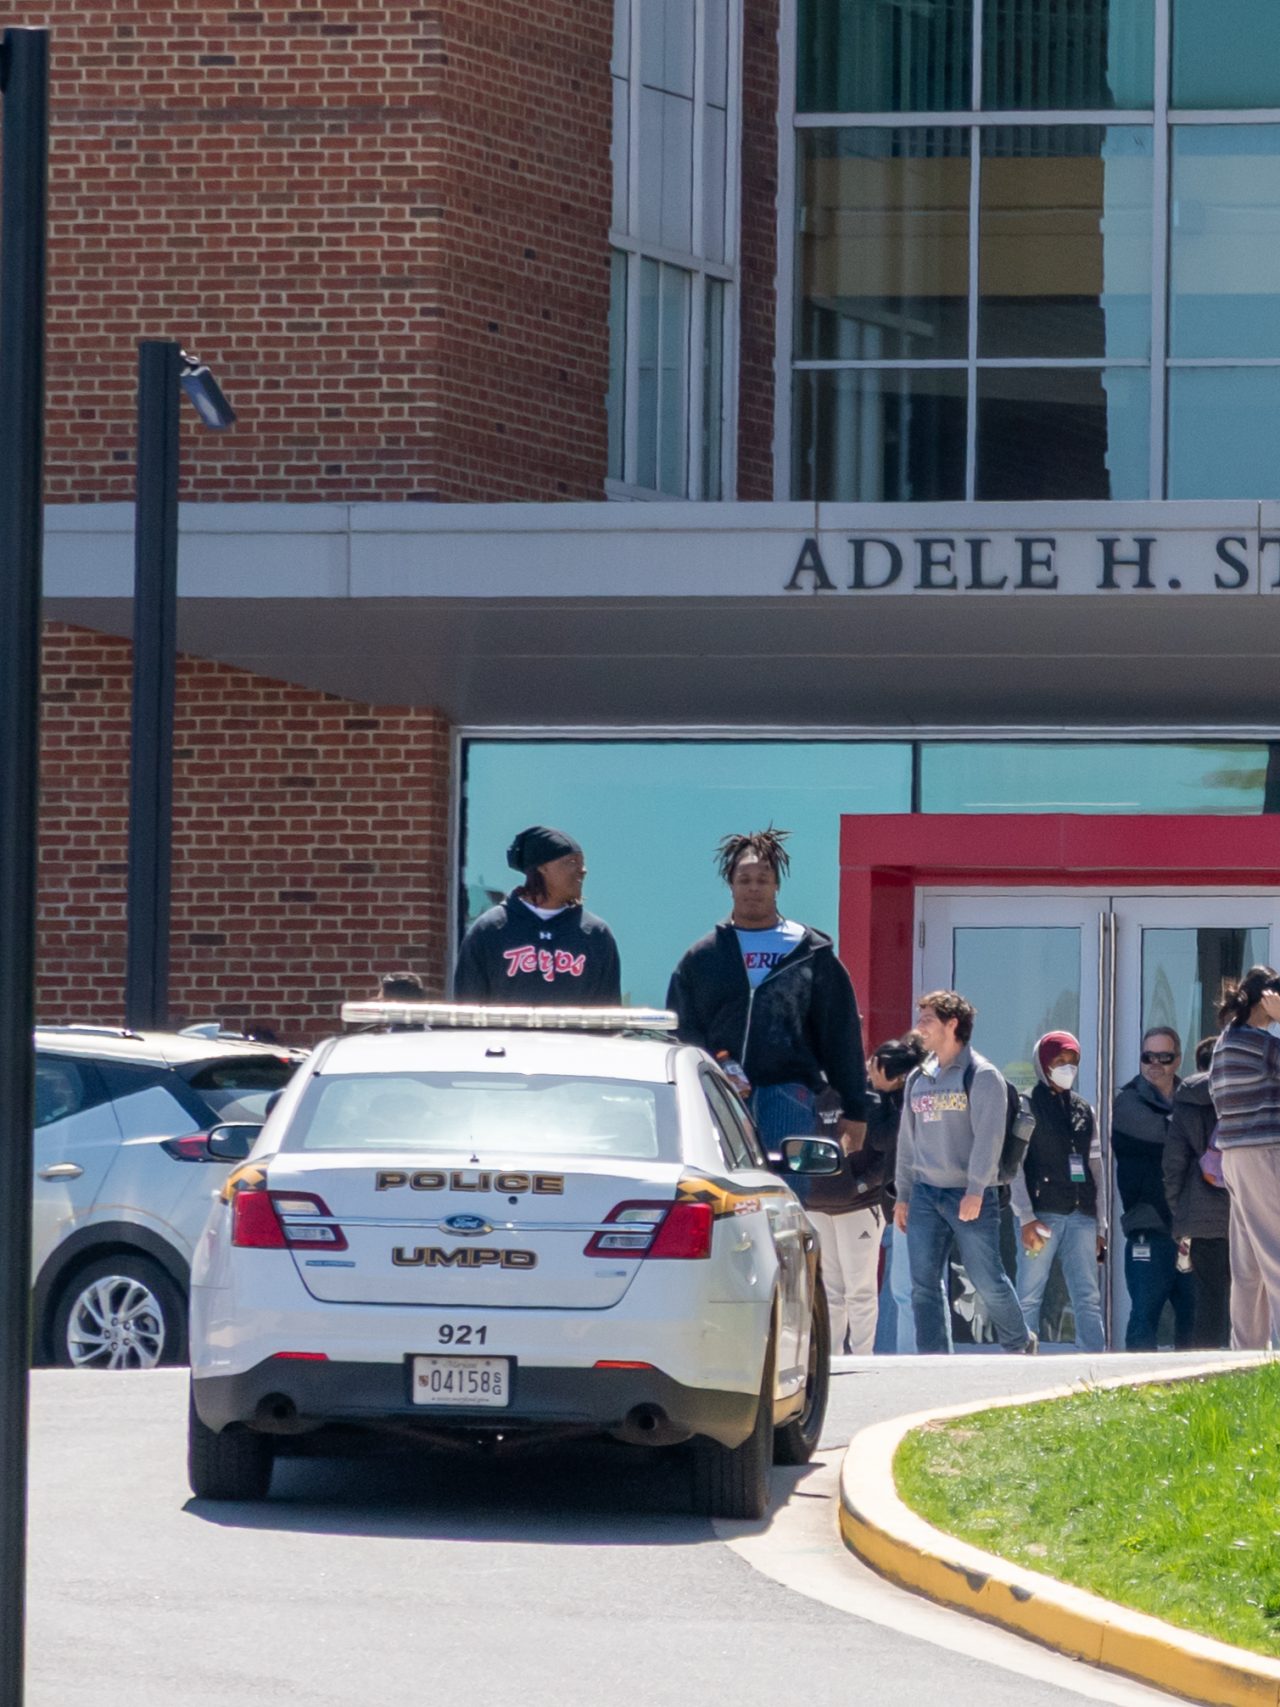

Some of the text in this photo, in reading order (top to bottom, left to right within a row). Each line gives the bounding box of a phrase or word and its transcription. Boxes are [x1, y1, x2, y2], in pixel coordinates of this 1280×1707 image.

[784, 536, 1059, 592] ADELE
[1095, 536, 1182, 591] H.
[503, 945, 586, 982] Terps
[375, 1171, 565, 1195] POLICE
[392, 1246, 538, 1269] UMPD
[438, 1324, 487, 1345] 921
[431, 1369, 490, 1394] 04158
